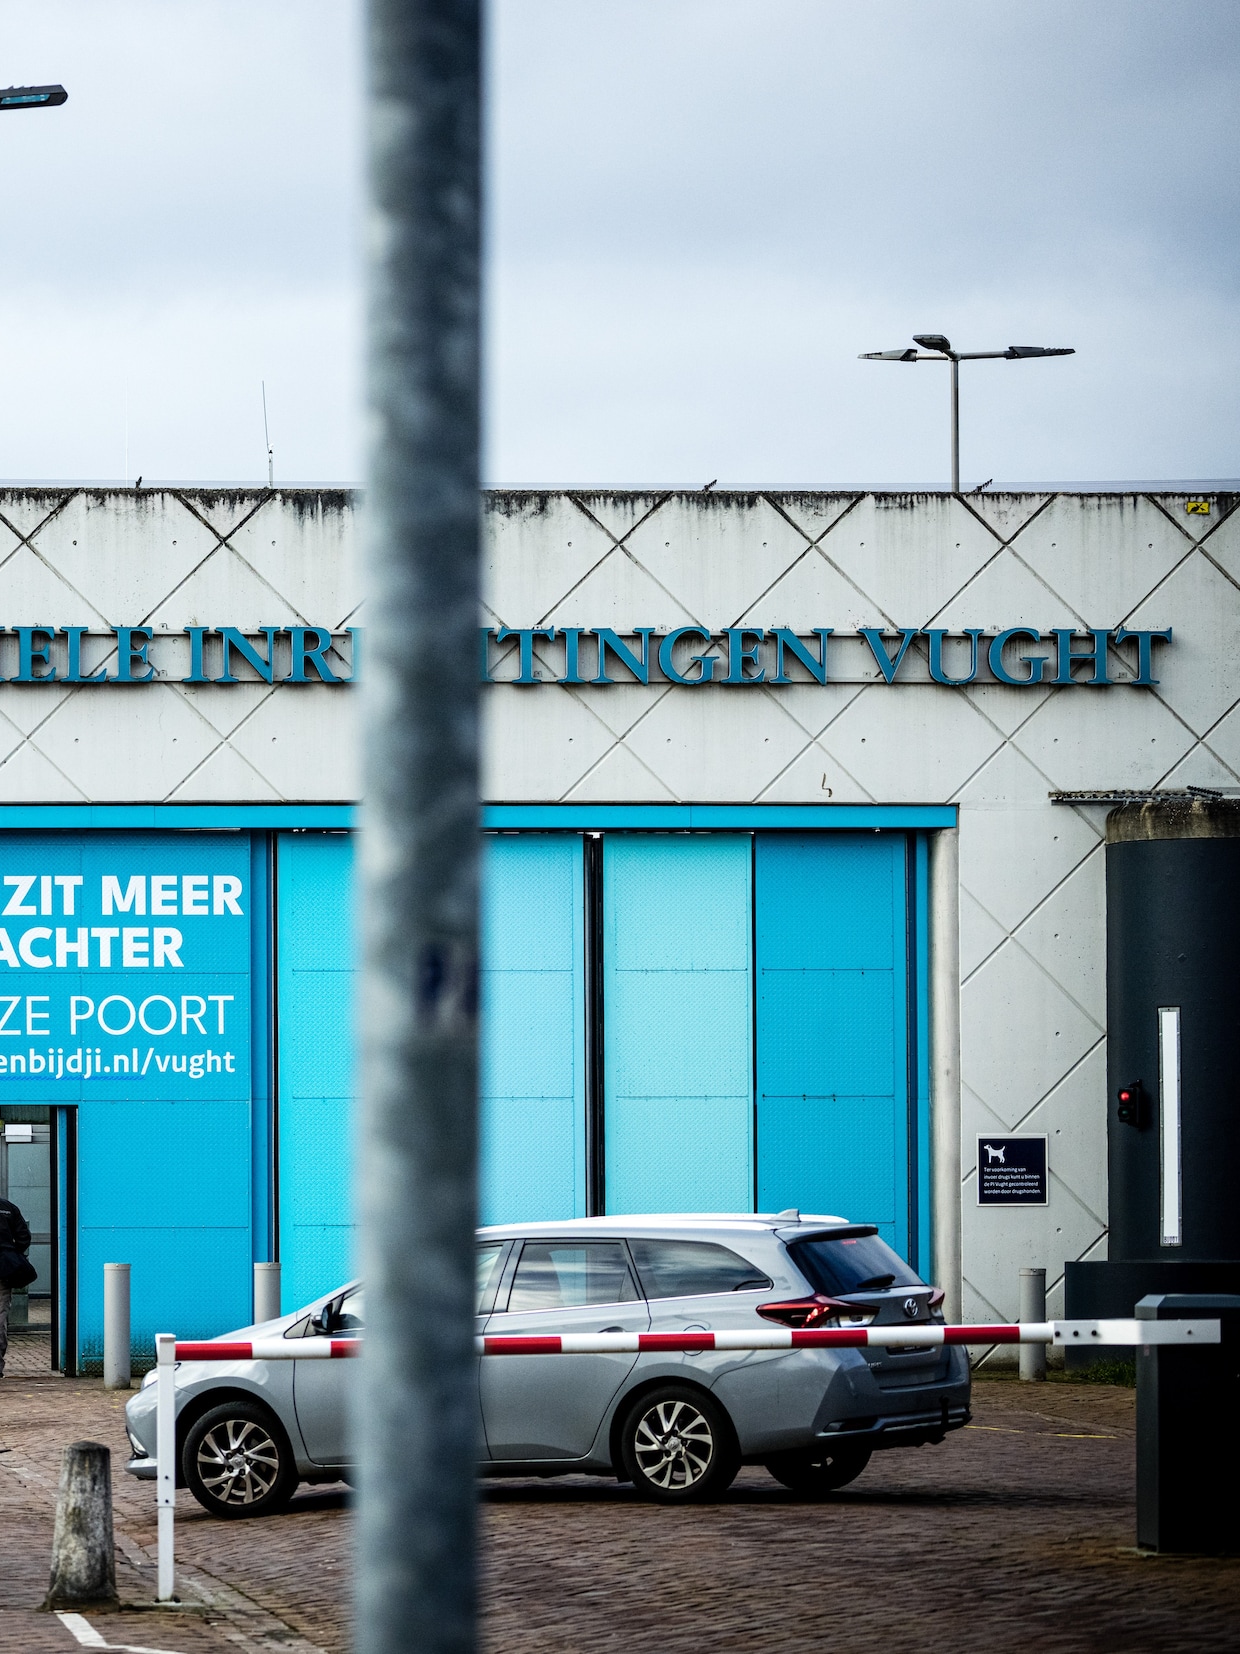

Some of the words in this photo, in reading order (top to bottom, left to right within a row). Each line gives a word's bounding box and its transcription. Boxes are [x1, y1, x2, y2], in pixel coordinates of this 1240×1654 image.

[181, 625, 829, 686] INRITINGEN
[863, 625, 1173, 686] VUGHT
[1, 875, 84, 916] ZIT
[101, 875, 245, 916] MEER
[70, 994, 235, 1036] POORT
